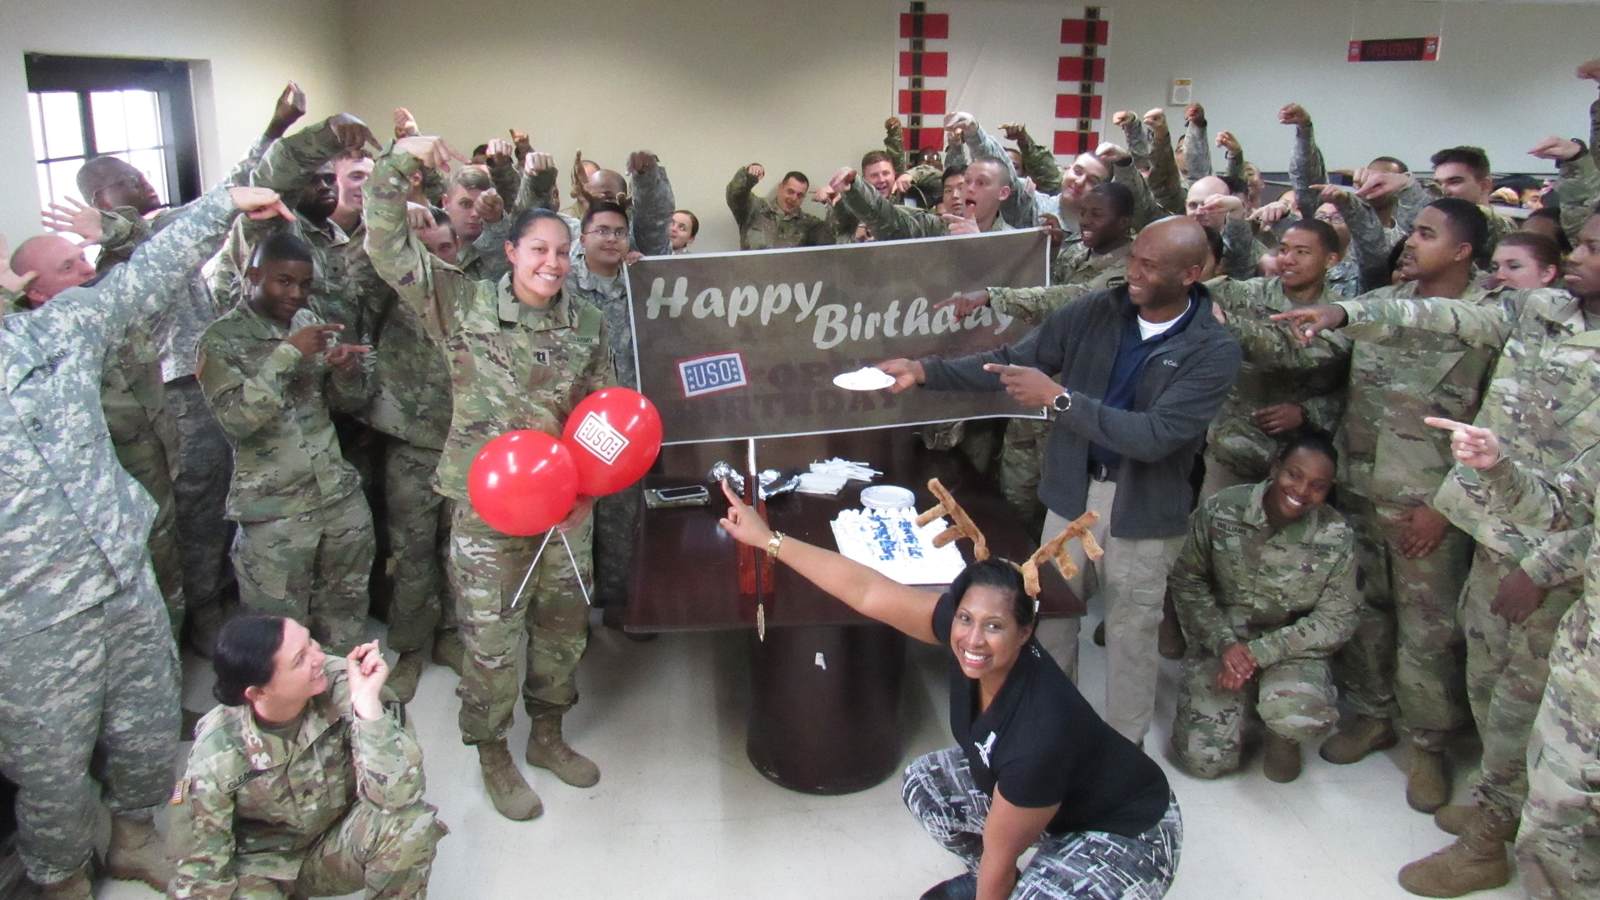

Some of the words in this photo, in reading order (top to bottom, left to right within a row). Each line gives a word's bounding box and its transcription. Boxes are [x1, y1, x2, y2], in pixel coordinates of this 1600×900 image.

[645, 276, 823, 328] Happy
[693, 361, 732, 388] USO
[585, 421, 615, 453] USO
